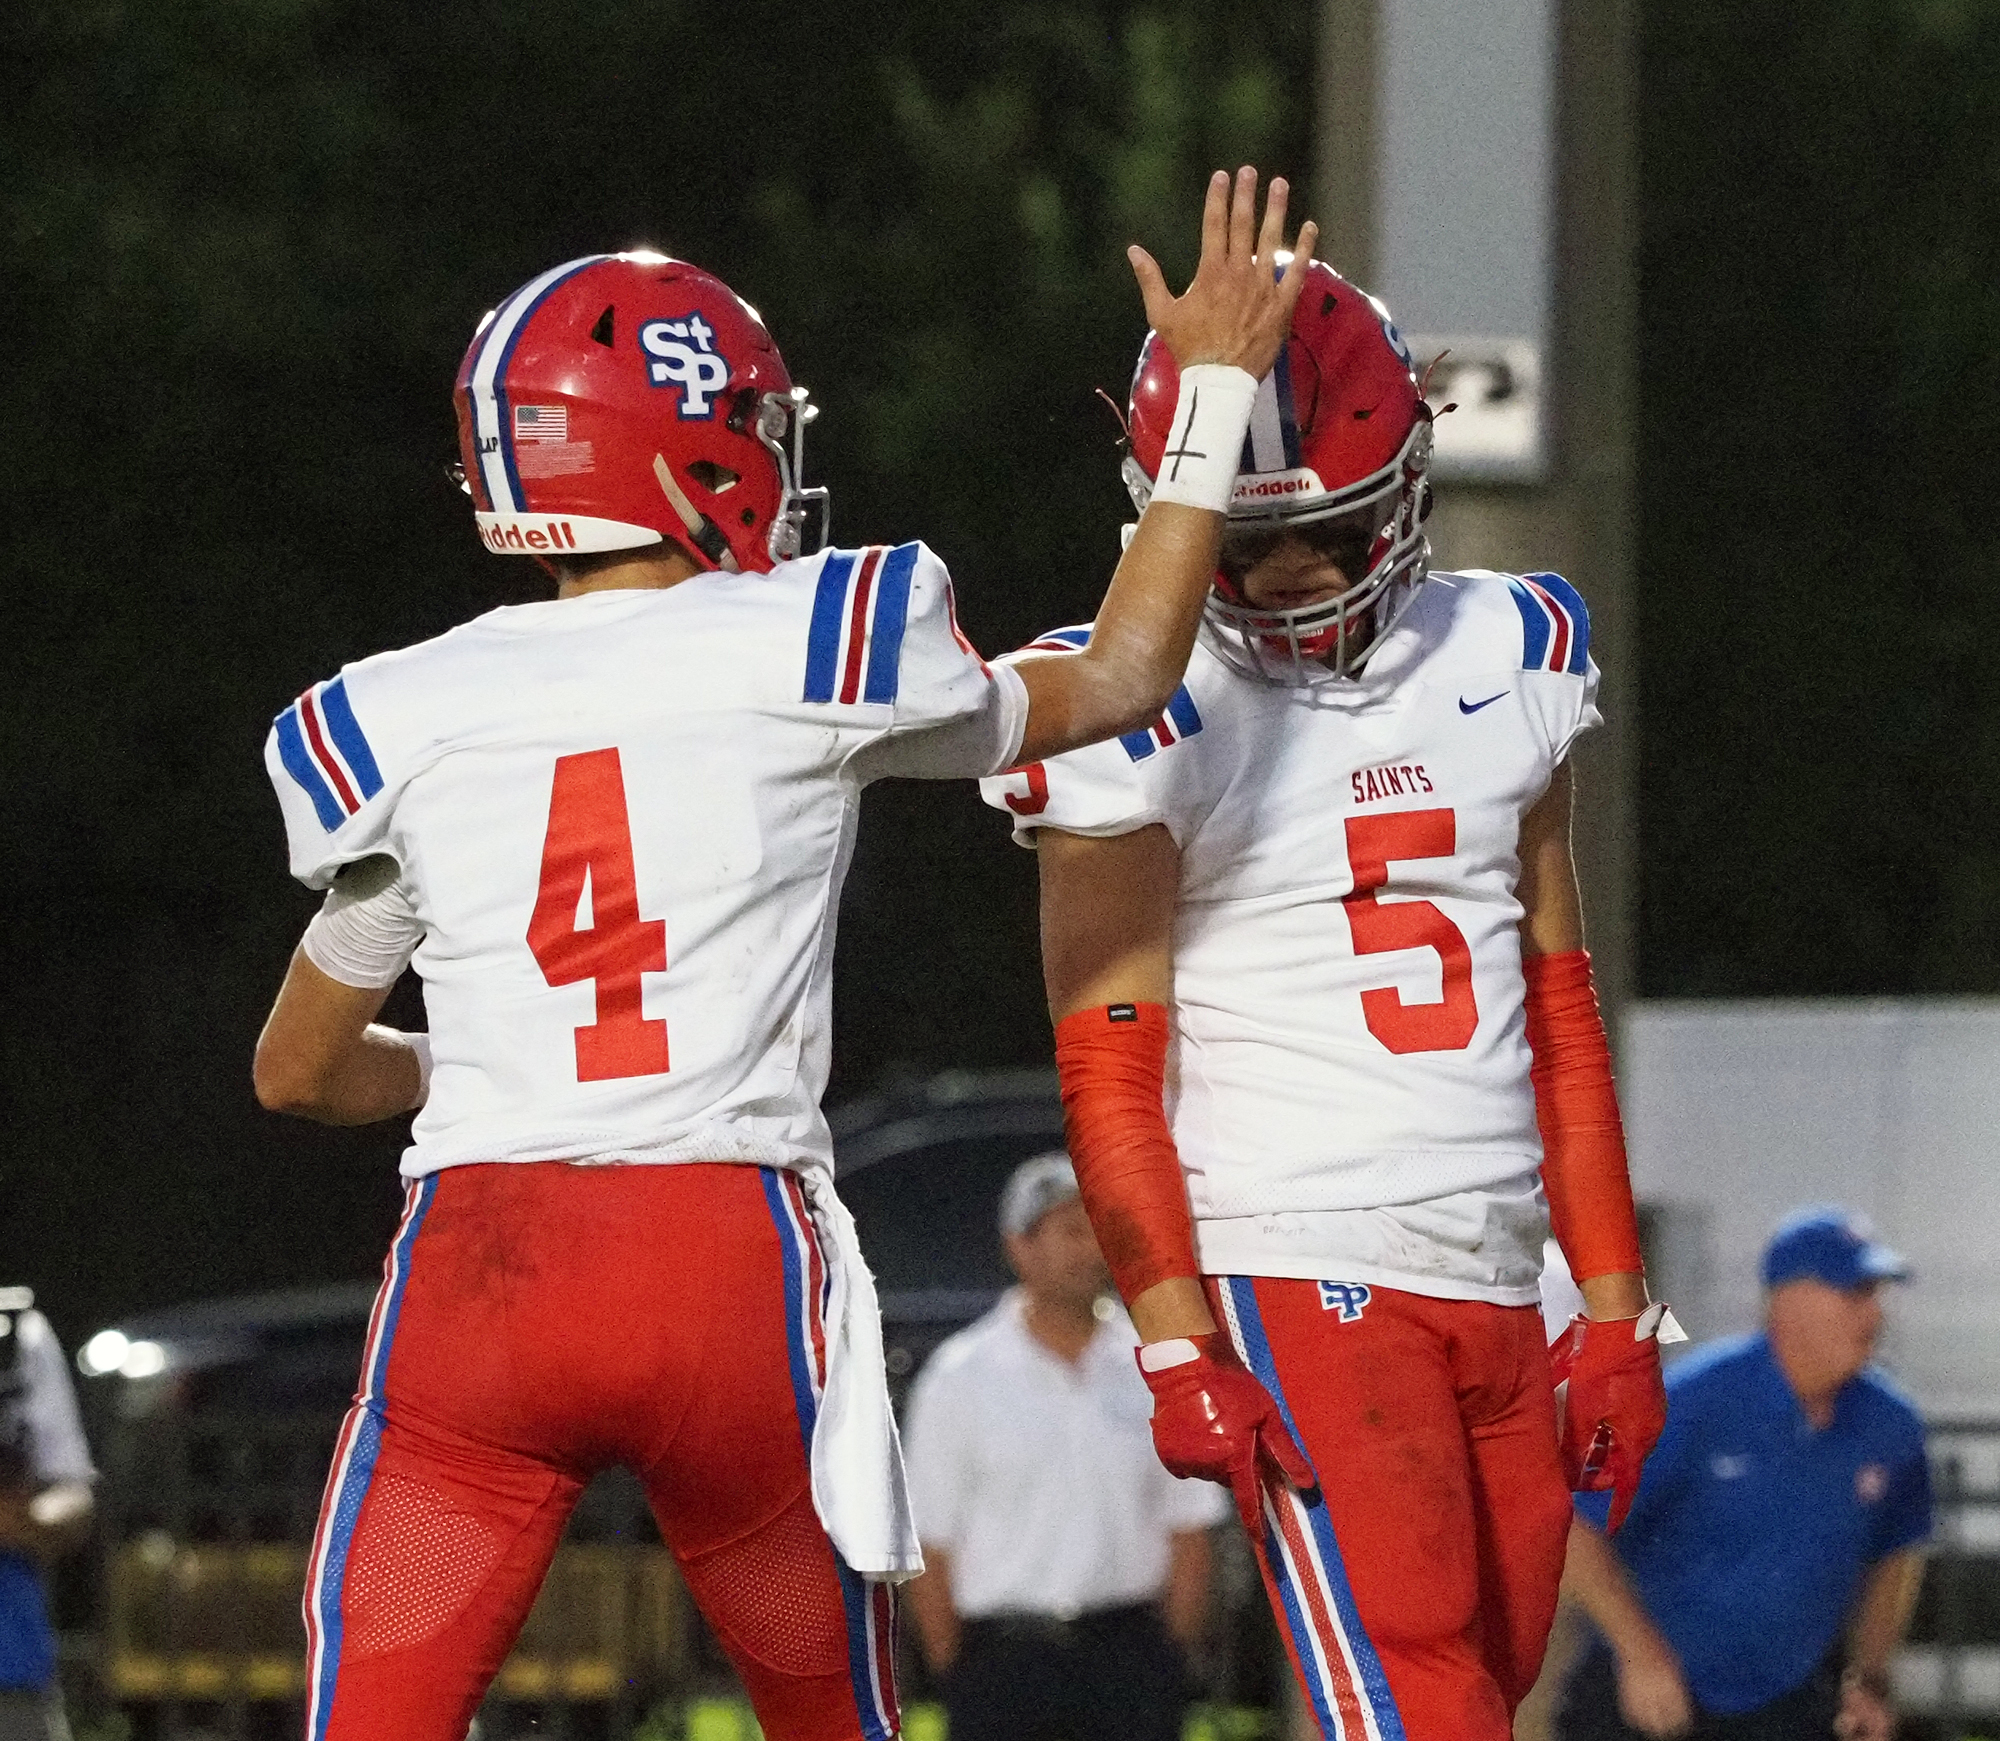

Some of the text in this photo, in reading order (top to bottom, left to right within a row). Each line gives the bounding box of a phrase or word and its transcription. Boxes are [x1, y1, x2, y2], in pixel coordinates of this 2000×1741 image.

[1352, 765, 1434, 804] SAINTS
[526, 747, 670, 1082] 4
[1343, 807, 1480, 1055] 5
